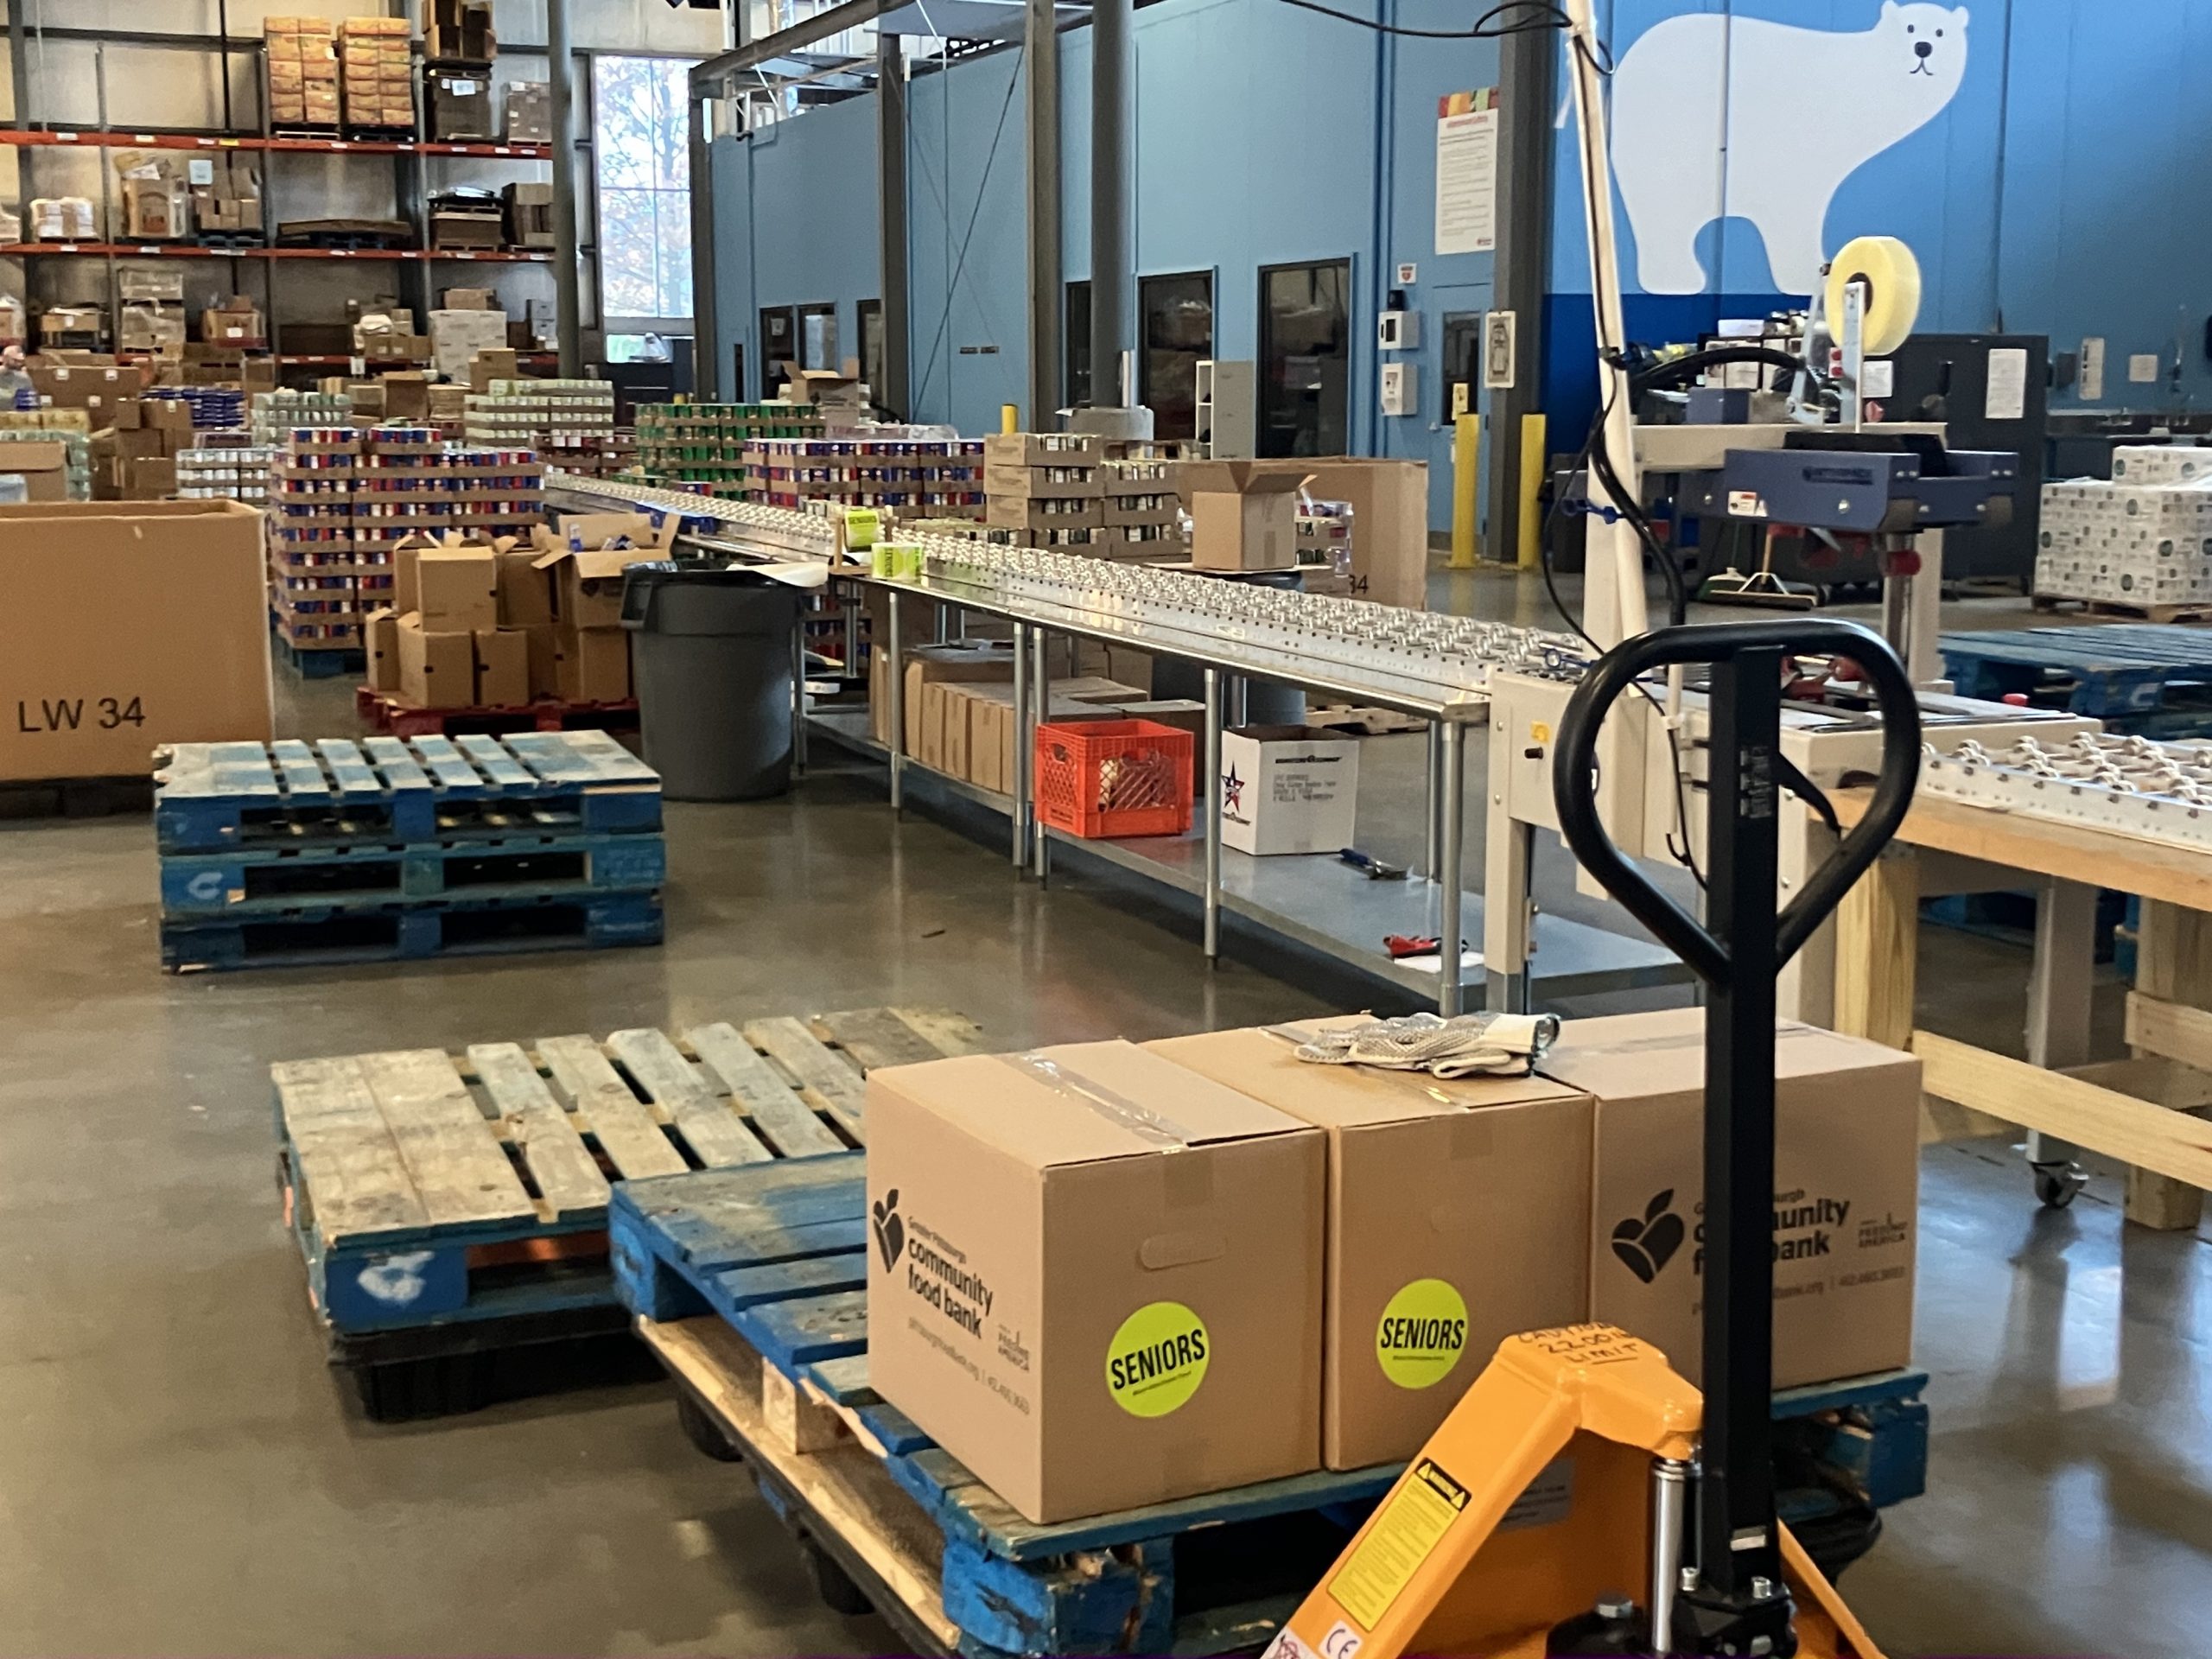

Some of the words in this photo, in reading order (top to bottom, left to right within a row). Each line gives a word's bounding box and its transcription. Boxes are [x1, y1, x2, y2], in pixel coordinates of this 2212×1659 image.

[1348, 574, 1369, 594] 34
[18, 698, 84, 732] LW
[98, 696, 146, 729] 34
[908, 1237, 993, 1317] community
[908, 1263, 940, 1310] food
[944, 1287, 982, 1339] bank
[1380, 1317, 1465, 1350] SENIORS
[1111, 1328, 1205, 1390] SENIORS
